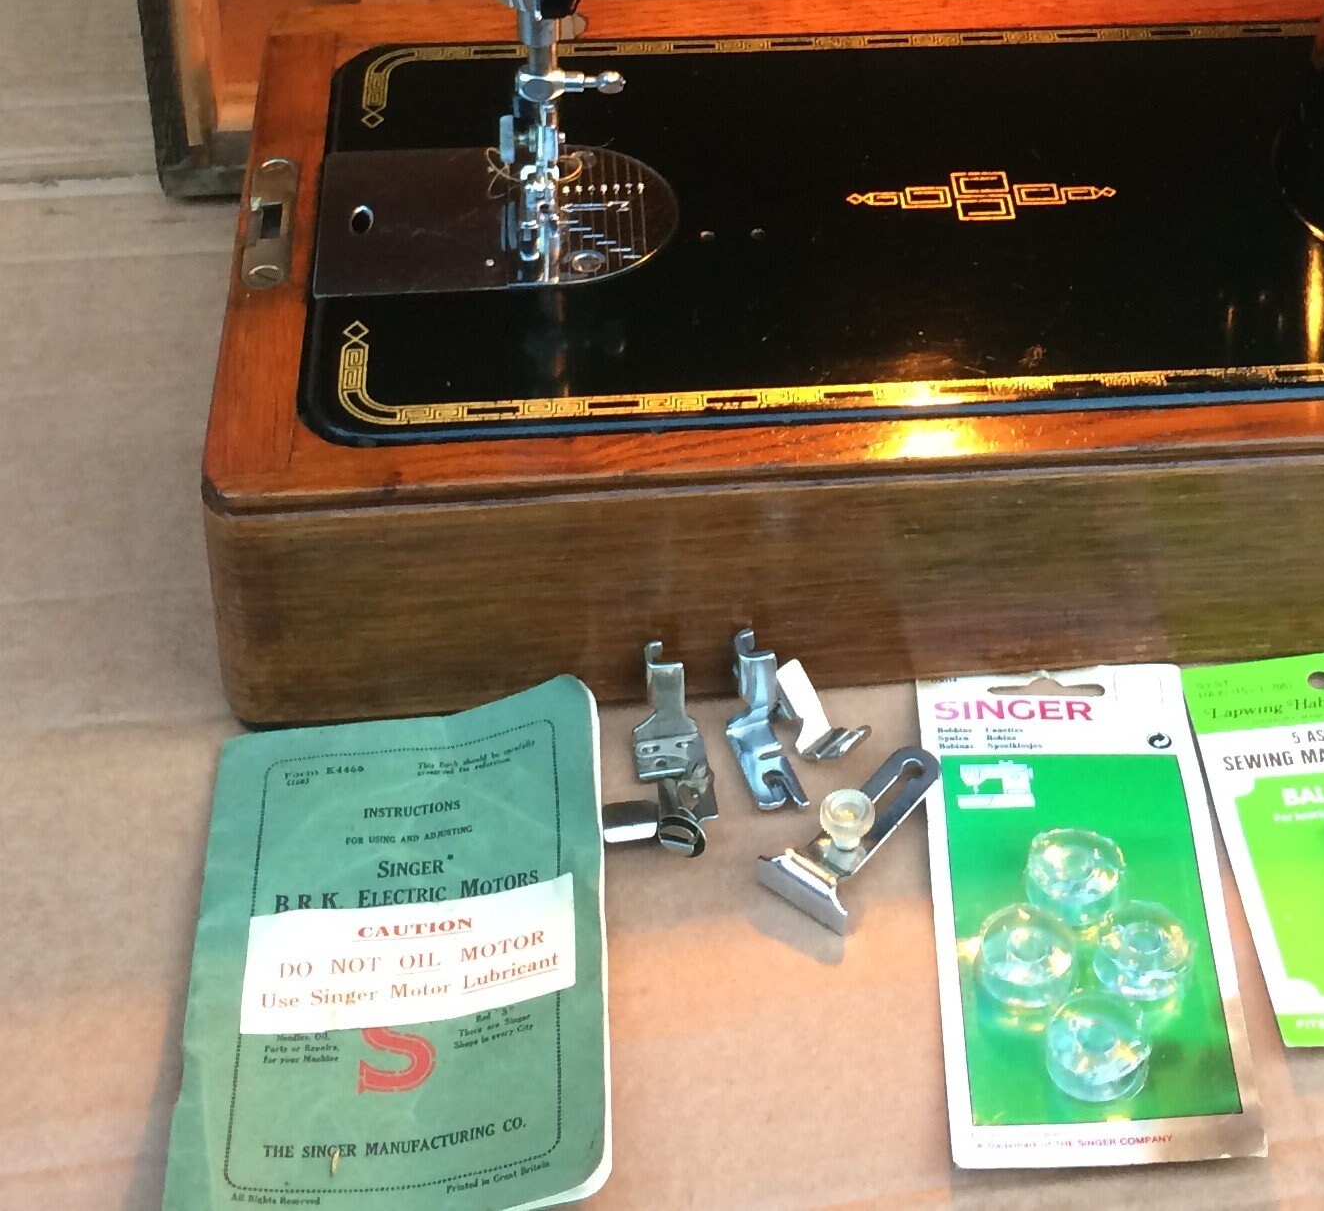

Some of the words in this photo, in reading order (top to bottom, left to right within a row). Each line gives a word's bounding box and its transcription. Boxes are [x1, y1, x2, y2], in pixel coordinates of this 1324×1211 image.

[934, 699, 1094, 721] SINGER
[1203, 701, 1283, 720] Lapwing
[1291, 731, 1301, 744] 5
[1222, 750, 1295, 772] SEWING
[363, 799, 461, 819] INSTRUCTIONS
[345, 836, 364, 845] FOR
[368, 835, 396, 844] USING
[400, 834, 420, 843] AND
[423, 825, 473, 841] ADJUSTING
[376, 859, 445, 879] SINGER
[357, 886, 447, 909] ELECTRIC
[460, 869, 540, 899] MOTORS
[357, 917, 473, 939] CAUTION
[279, 961, 313, 979] DO
[330, 956, 382, 976] NOT
[399, 951, 442, 970] OIL
[460, 929, 545, 964] MOTOR
[261, 992, 300, 1009] Use
[310, 988, 379, 1007] Singer
[390, 982, 452, 1000] Motor
[463, 951, 559, 990] Lubricant
[263, 1144, 295, 1159] THE
[301, 1143, 358, 1159] SINGER
[364, 1123, 496, 1157] MANUFACTURING
[502, 1116, 528, 1133] CO.
[1077, 1138, 1117, 1147] SINGER
[1119, 1135, 1173, 1147] COMPANY
